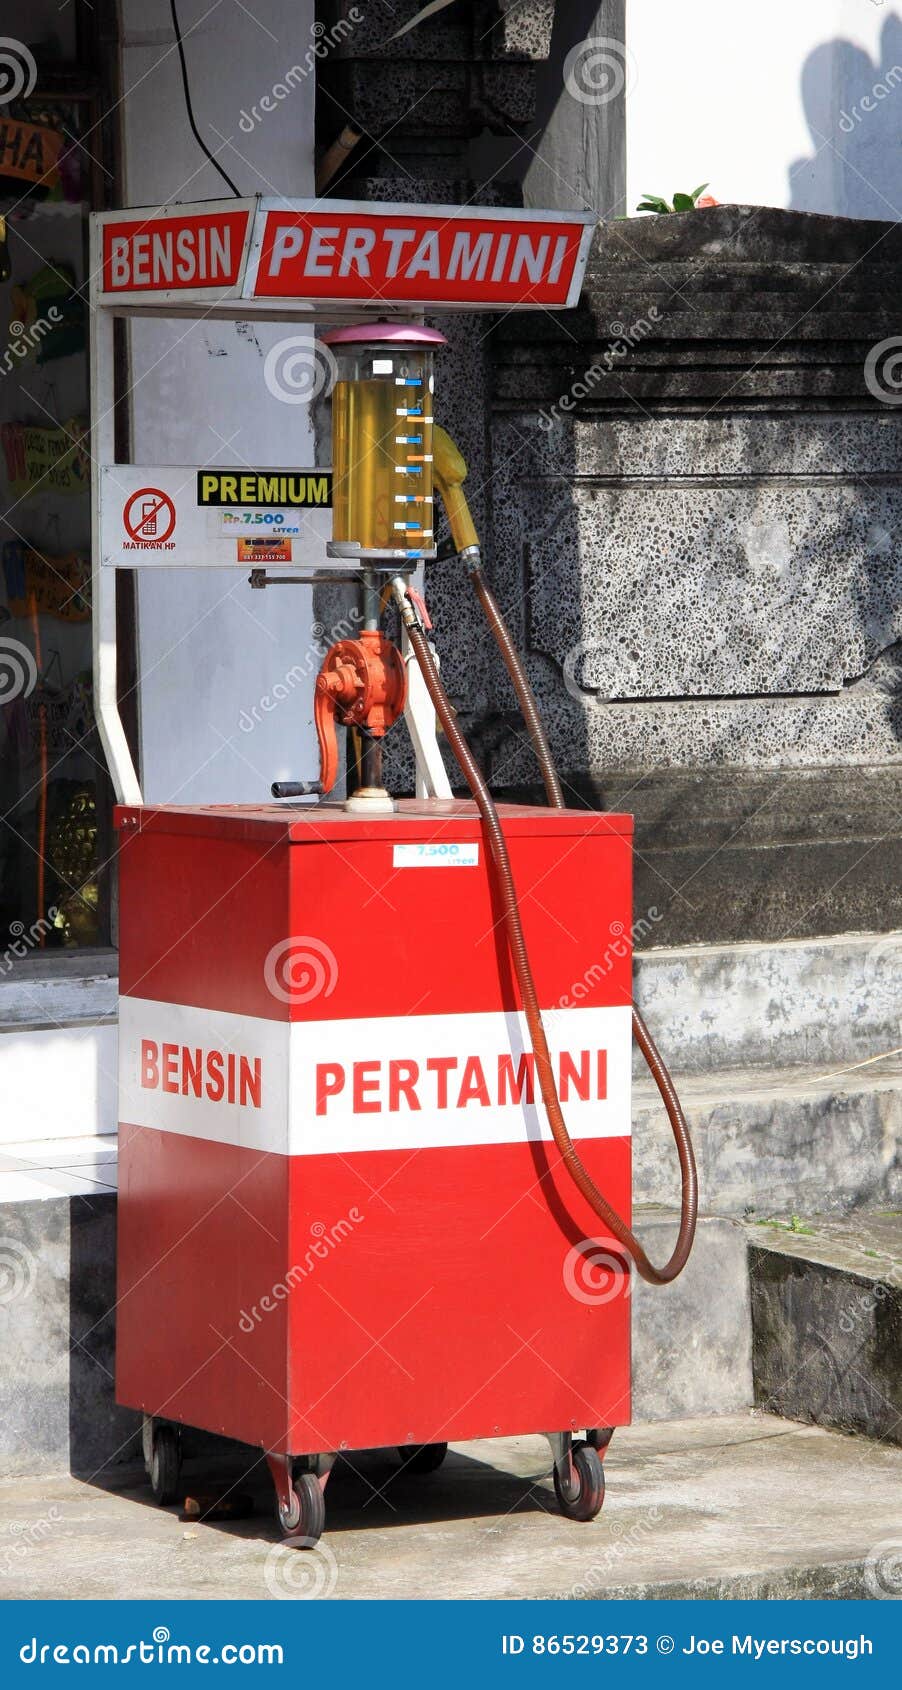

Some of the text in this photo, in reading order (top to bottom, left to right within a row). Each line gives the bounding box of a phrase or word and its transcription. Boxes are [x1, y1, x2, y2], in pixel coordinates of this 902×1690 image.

[111, 225, 232, 287] BENSIN
[268, 226, 568, 284] PERTAMINI
[202, 476, 328, 504] PREMIUM
[123, 541, 176, 550] MATIKAN HP
[141, 1039, 262, 1108] BENSIN
[315, 1049, 608, 1116] PERTAMNI
